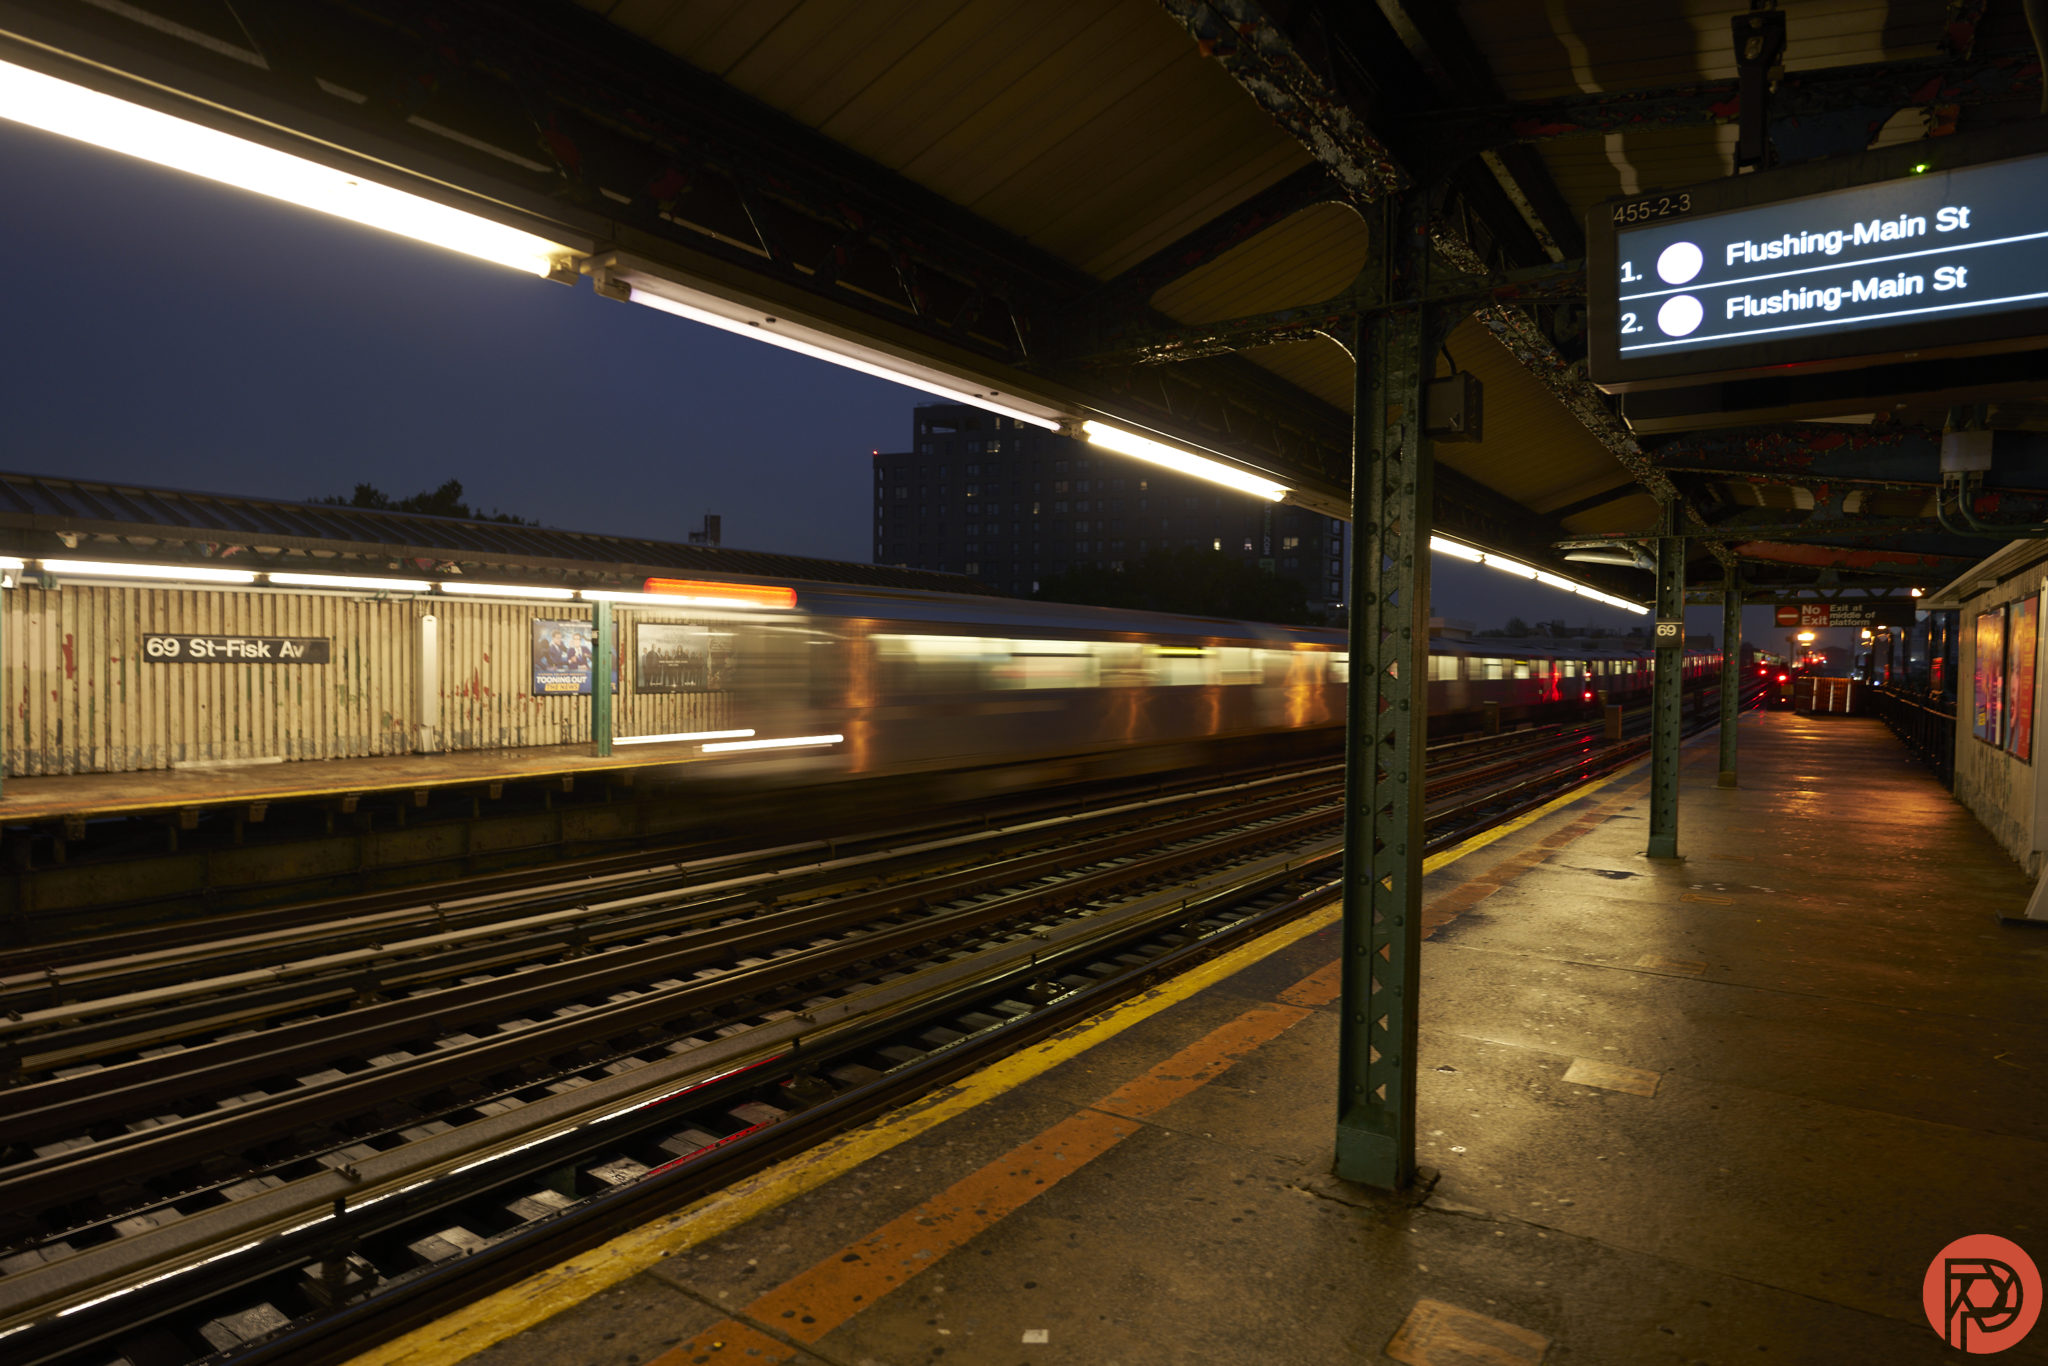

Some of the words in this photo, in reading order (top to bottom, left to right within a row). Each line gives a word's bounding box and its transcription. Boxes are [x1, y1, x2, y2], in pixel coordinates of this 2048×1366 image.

[1614, 193, 1691, 223] 455-2-3
[1621, 261, 1643, 283] 1.
[1726, 216, 1926, 266] Flushing-Main
[1935, 205, 1971, 232] St
[1621, 312, 1644, 334] 2.
[1726, 275, 1924, 320] Flushing-Main
[1934, 266, 1968, 292] St
[1801, 605, 1821, 615] No
[1801, 616, 1828, 625] Exit
[1830, 619, 1871, 627] platform
[1656, 624, 1677, 637] 69
[146, 637, 180, 657] 69
[189, 638, 271, 658] St-Fisk
[279, 640, 304, 658] Av
[536, 676, 571, 684] TOONING
[571, 676, 587, 684] OUT
